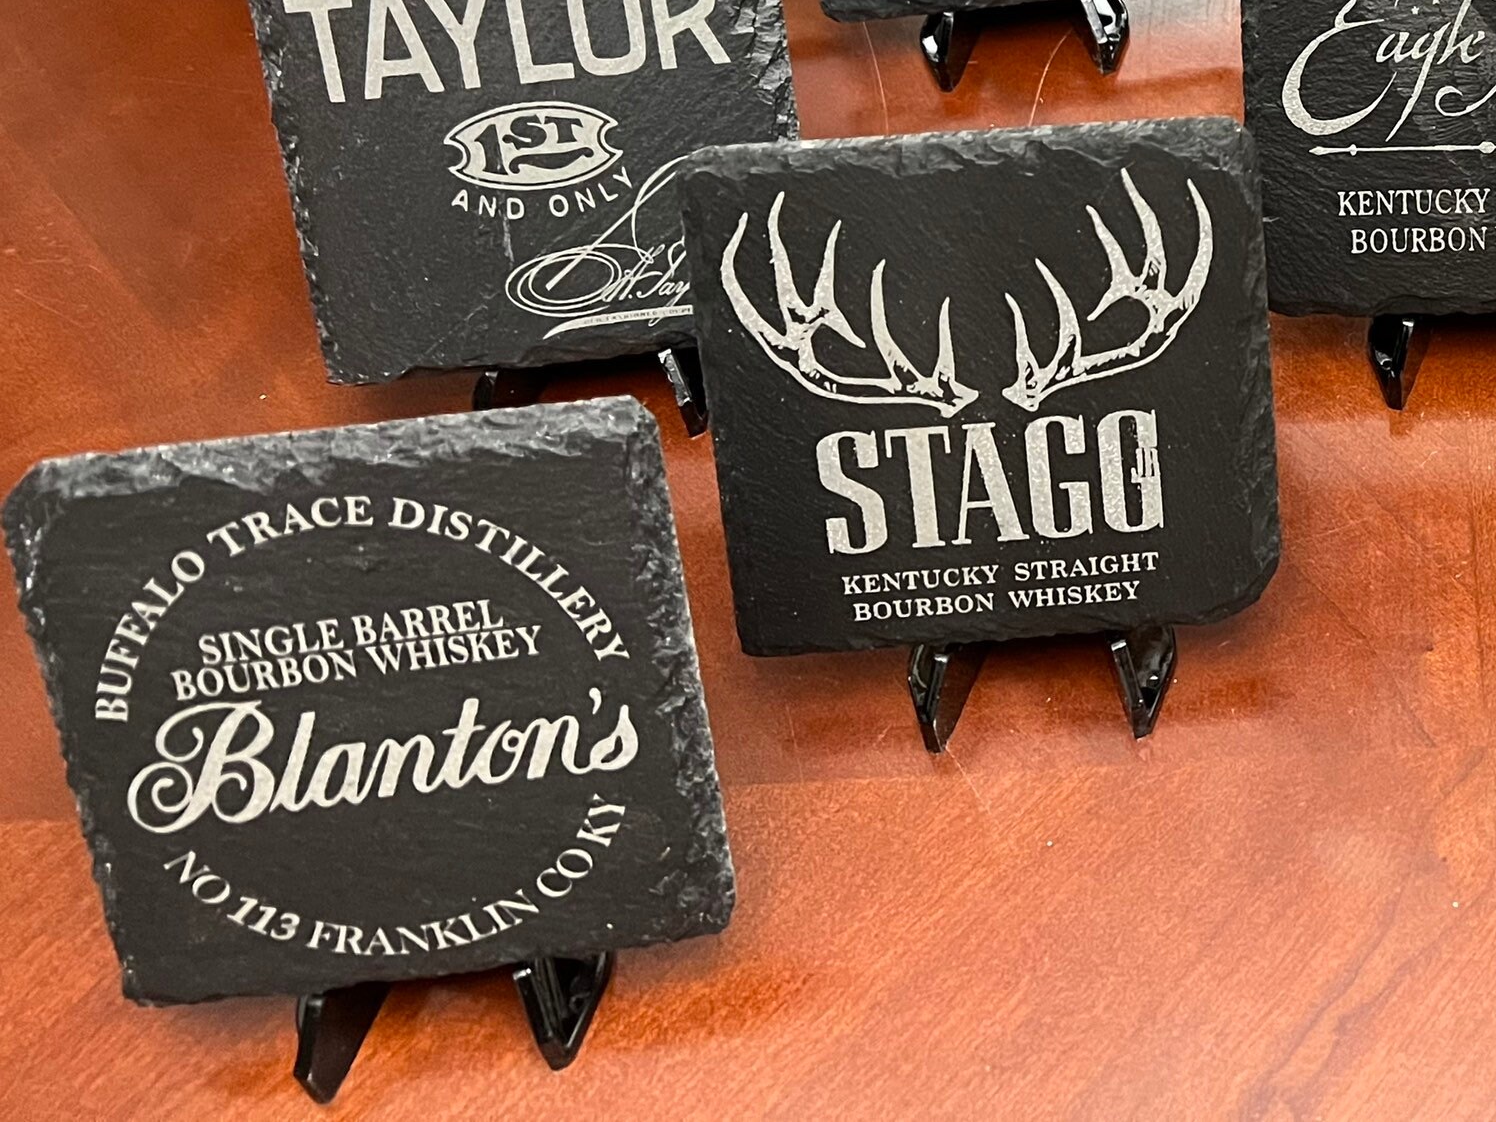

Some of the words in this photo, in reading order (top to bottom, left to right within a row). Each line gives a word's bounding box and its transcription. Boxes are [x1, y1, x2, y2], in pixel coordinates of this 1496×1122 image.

[473, 114, 594, 176] 1ST
[451, 189, 525, 221] AND
[549, 166, 635, 218] ONLY
[1337, 187, 1490, 217] KENTUCKY
[1351, 226, 1488, 255] BOURBON
[815, 408, 1164, 555] STAGG
[842, 564, 1000, 596] KENTUCKY
[1014, 551, 1160, 582] STRAIGHT
[853, 593, 995, 623] BOURBON
[1008, 580, 1141, 610] WHISKEY
[95, 549, 207, 724] BUFFALO
[206, 495, 374, 559] TRACE
[387, 496, 631, 664] DISTILLERY
[198, 618, 345, 667] SINGLE
[354, 599, 505, 647] BARREL
[170, 648, 357, 702] BOURBON
[365, 624, 543, 675] WHISKEY
[126, 686, 640, 835] Blanton's
[163, 850, 233, 906] NO
[226, 895, 301, 943] 113
[306, 888, 541, 957] FRANKLIN
